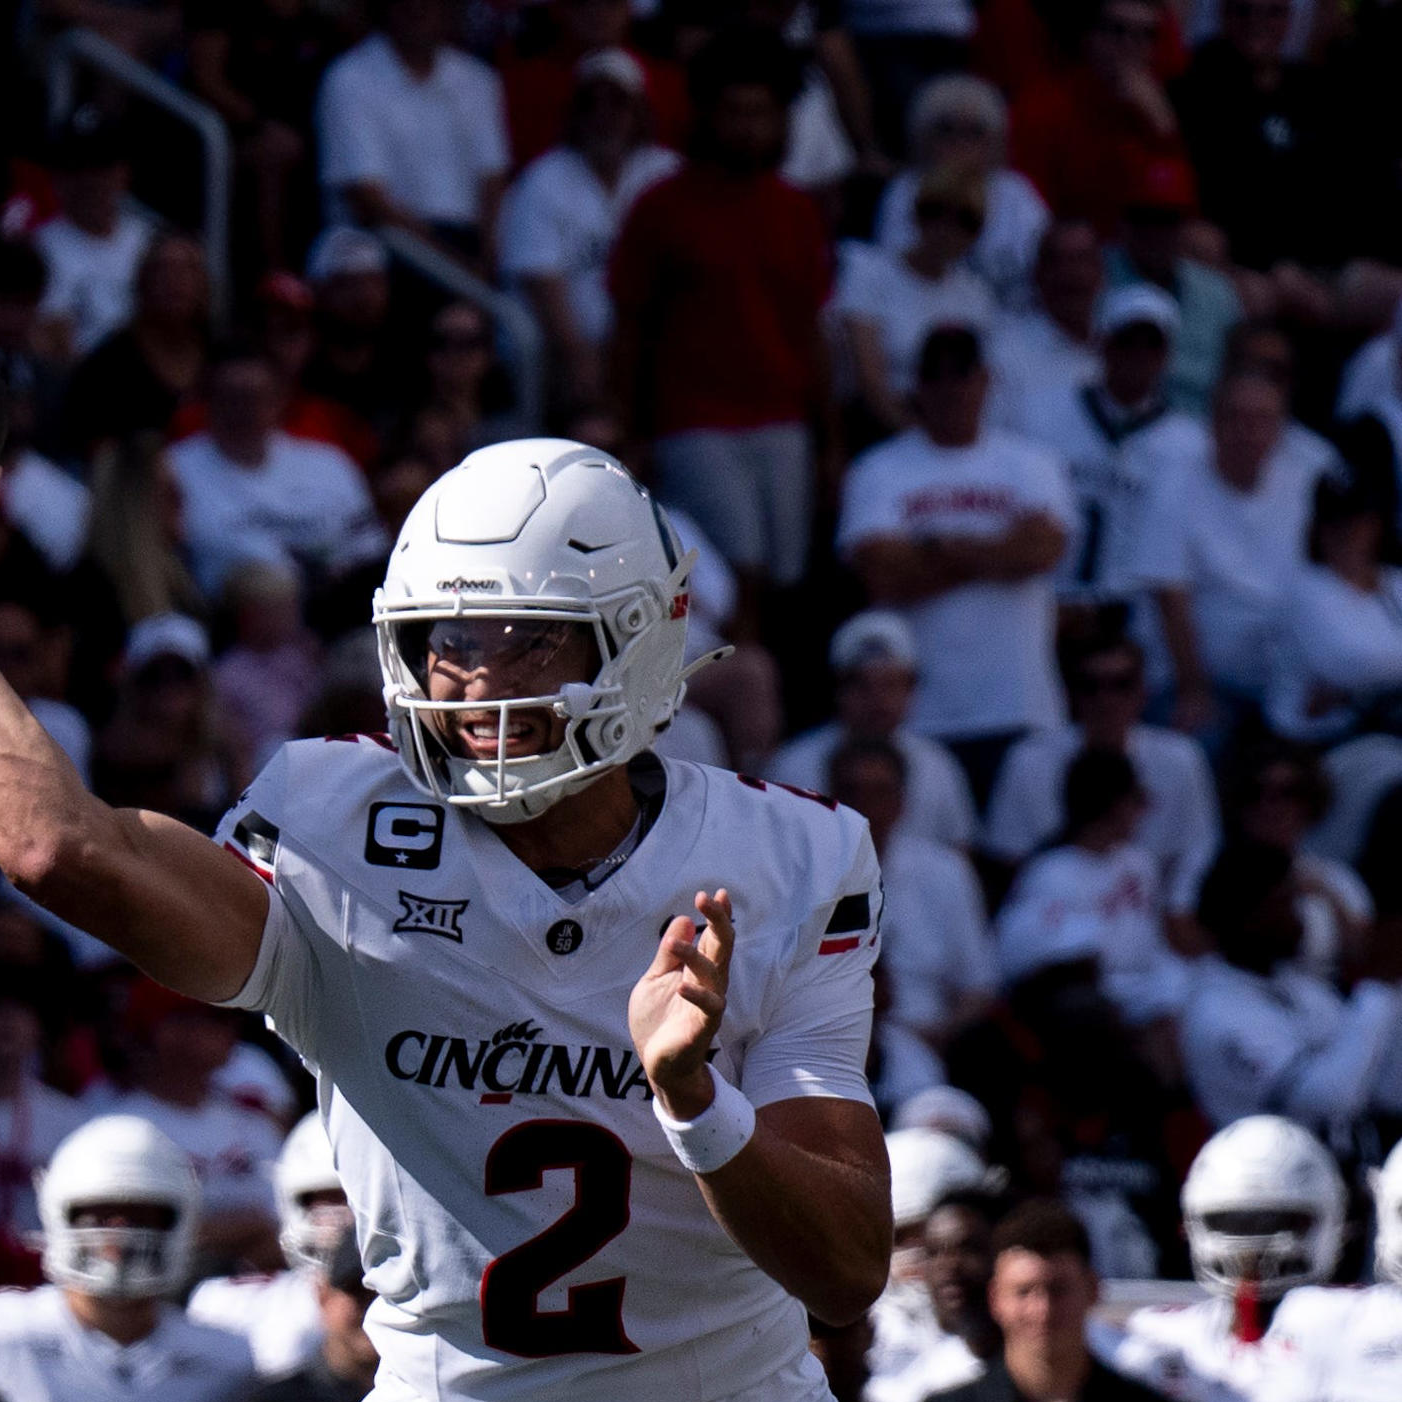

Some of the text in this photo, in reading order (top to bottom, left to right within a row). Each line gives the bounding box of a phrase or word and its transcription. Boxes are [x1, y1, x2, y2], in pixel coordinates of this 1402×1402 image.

[374, 806, 437, 850] C
[399, 893, 466, 941] XII
[558, 924, 574, 938] JK
[555, 938, 572, 952] 58
[385, 1024, 721, 1101] CINCINNA
[480, 1118, 643, 1358] 2
